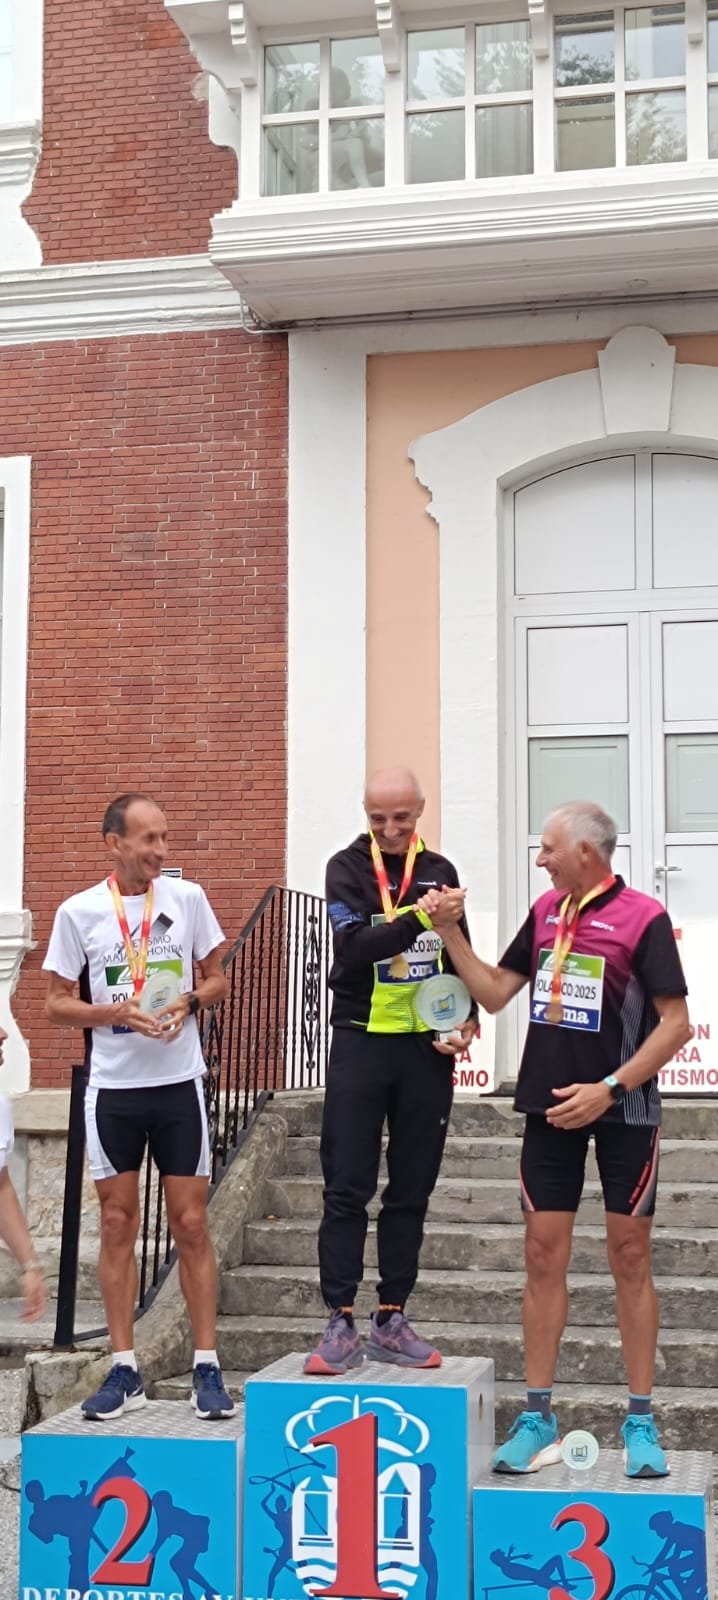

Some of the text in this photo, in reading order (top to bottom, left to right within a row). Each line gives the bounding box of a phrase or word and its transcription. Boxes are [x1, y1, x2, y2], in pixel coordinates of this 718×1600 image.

[103, 944, 183, 963] MAJHONDA
[536, 979, 596, 1000] OLACO 2025
[659, 1069, 718, 1086] TISMO
[90, 1476, 155, 1587] 2
[308, 1411, 403, 1600] 1
[548, 1502, 616, 1600] 3
